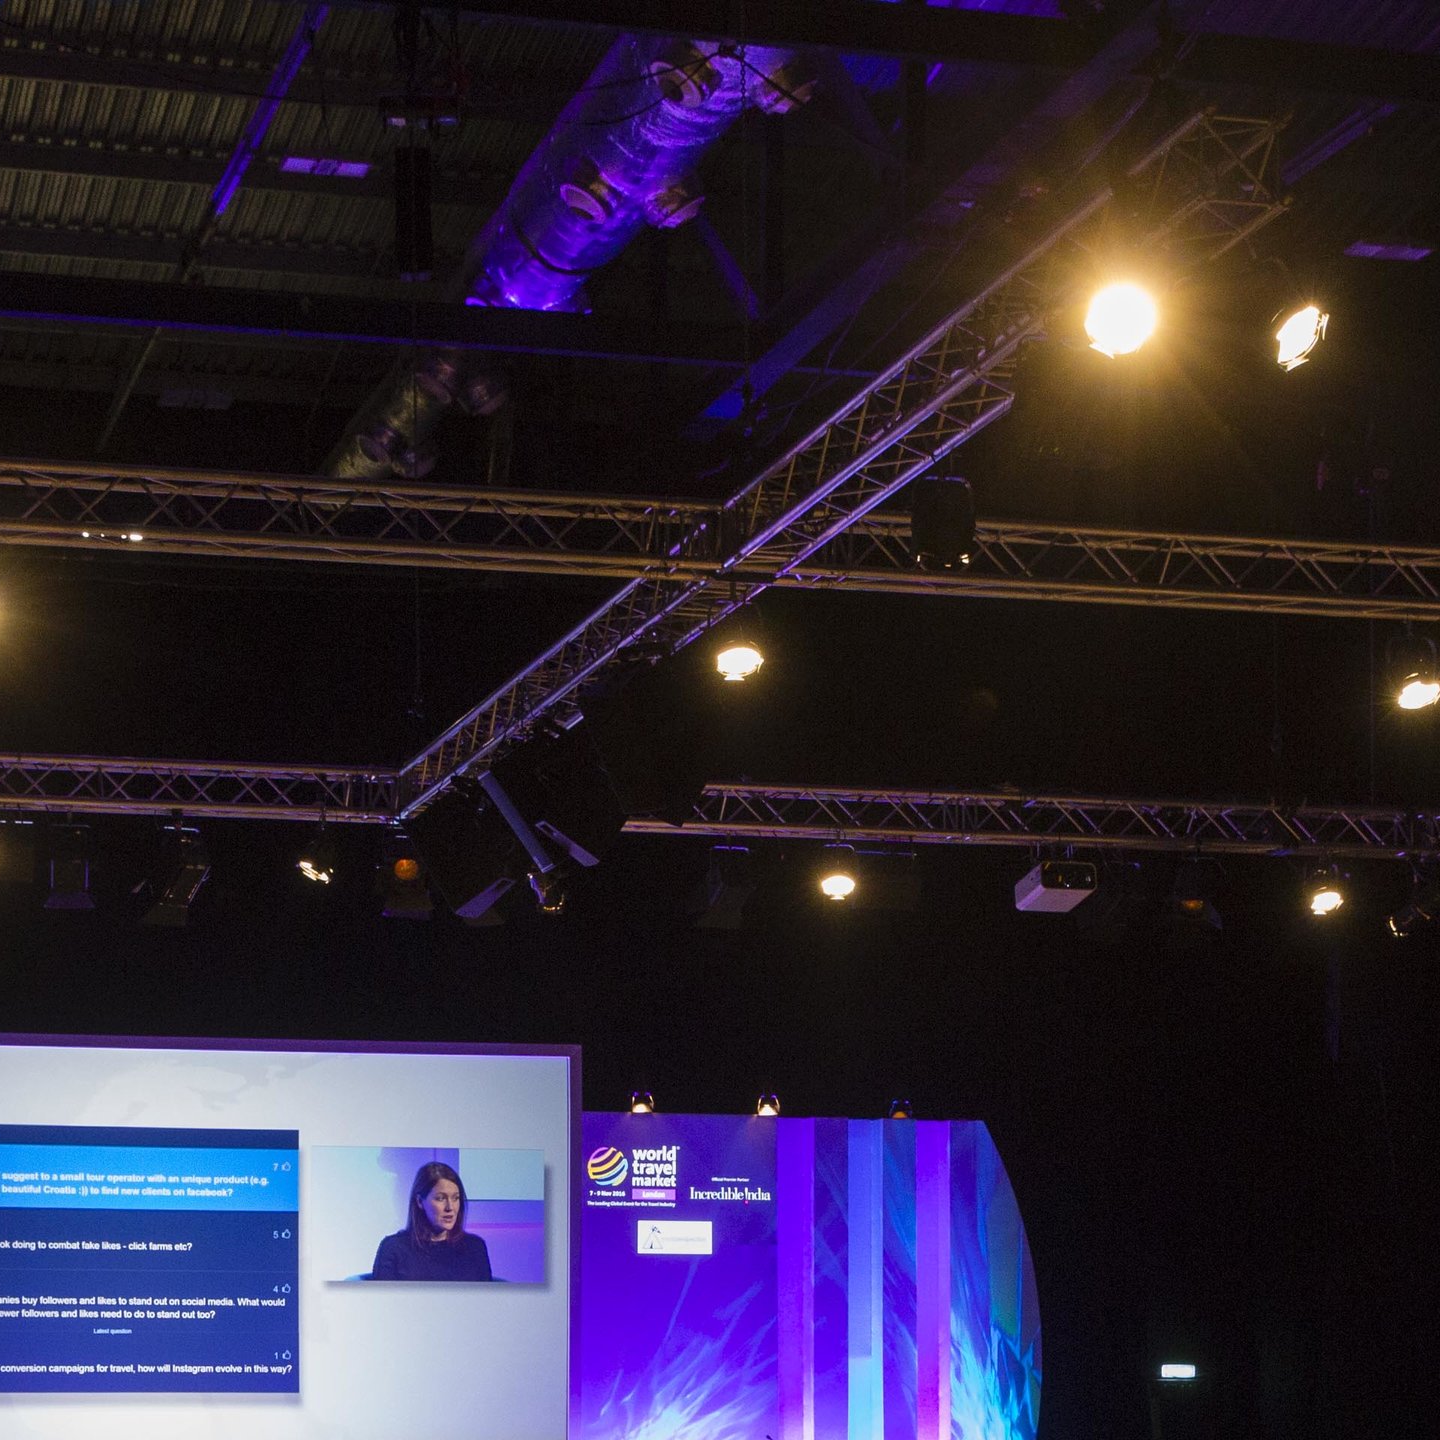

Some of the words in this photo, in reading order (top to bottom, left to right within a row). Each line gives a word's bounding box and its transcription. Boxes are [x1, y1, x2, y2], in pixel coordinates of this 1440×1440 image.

[632, 1146, 676, 1161] world
[273, 1163, 279, 1171] 7
[632, 1161, 676, 1176] travel
[2, 1172, 39, 1183] suggest
[41, 1173, 50, 1181] to
[60, 1173, 84, 1182] small
[87, 1173, 105, 1182] tour
[107, 1174, 145, 1184] operator
[147, 1174, 166, 1183] with
[168, 1176, 179, 1184] an
[181, 1174, 212, 1186] unique
[214, 1175, 248, 1186] product
[250, 1176, 269, 1187] (e.g.
[632, 1175, 676, 1187] market
[2, 1184, 42, 1194] beautiful
[44, 1185, 77, 1195] Croatia
[90, 1187, 100, 1196] to
[102, 1186, 119, 1196] find
[121, 1188, 139, 1196] new
[141, 1187, 171, 1197] clients
[173, 1189, 185, 1197] on
[187, 1187, 233, 1198] facebook?
[690, 1187, 744, 1200] Incredible
[273, 1230, 279, 1239] 5
[12, 1240, 36, 1251] doing
[38, 1240, 47, 1249] to
[48, 1240, 80, 1250] combat
[82, 1241, 100, 1250] fake
[102, 1241, 121, 1250] likes
[129, 1241, 148, 1251] click
[149, 1241, 173, 1251] farms
[175, 1242, 192, 1252] etc?
[273, 1285, 279, 1293] 4
[22, 1295, 38, 1306] buy
[40, 1295, 77, 1306] followers
[79, 1296, 95, 1306] and
[97, 1296, 116, 1306] likes
[118, 1297, 127, 1306] to
[129, 1296, 152, 1306] stand
[154, 1298, 167, 1306] out
[182, 1297, 206, 1307] social
[208, 1297, 235, 1307] media.
[237, 1297, 259, 1307] What
[261, 1297, 285, 1307] would
[22, 1309, 59, 1319] followers
[61, 1309, 77, 1319] and
[79, 1309, 99, 1319] likes
[101, 1309, 122, 1319] need
[124, 1310, 132, 1319] to
[134, 1309, 145, 1319] do
[147, 1310, 155, 1319] to
[157, 1309, 180, 1320] stand
[182, 1310, 195, 1320] out
[197, 1310, 215, 1320] too?
[0, 1363, 47, 1373] conversion
[49, 1363, 95, 1375] campaigns
[97, 1363, 108, 1373] for
[110, 1363, 135, 1375] travel,
[138, 1364, 155, 1374] how
[157, 1364, 171, 1374] will
[173, 1364, 213, 1376] Instagram
[215, 1364, 242, 1374] evolve
[244, 1364, 252, 1374] in
[254, 1364, 268, 1374] this
[270, 1365, 292, 1376] way?
